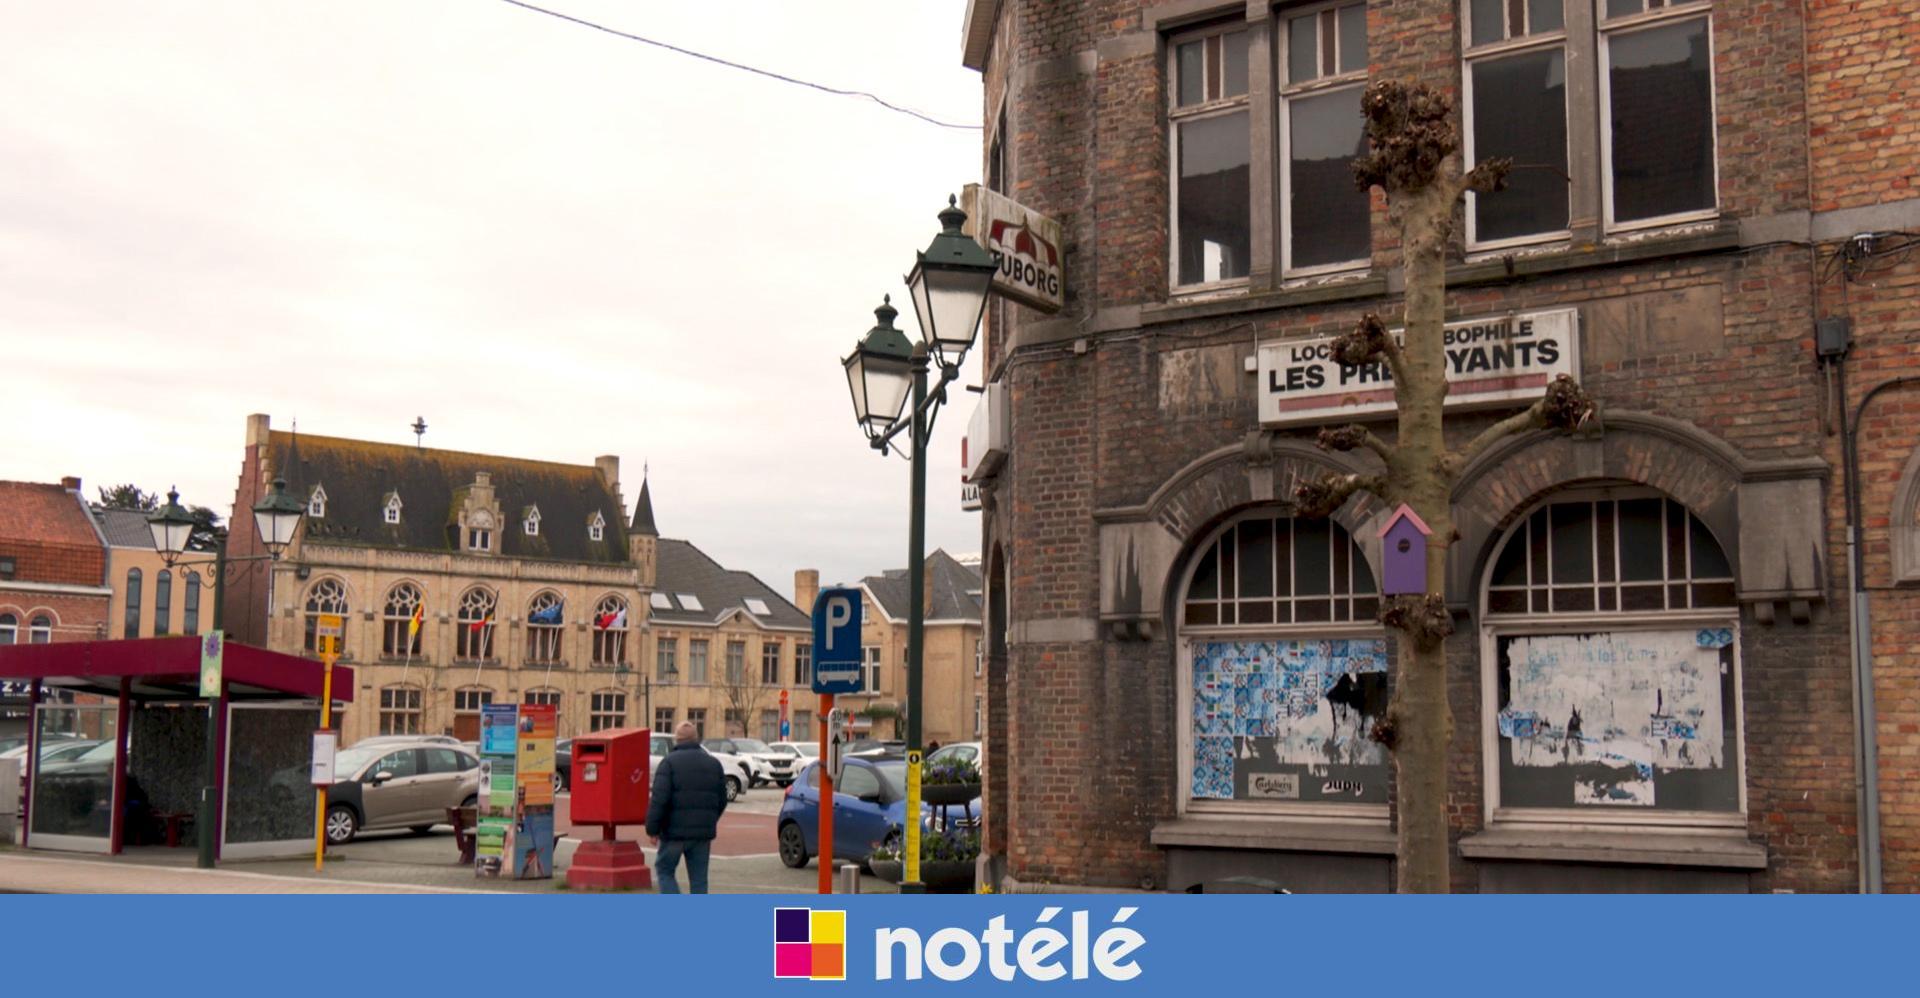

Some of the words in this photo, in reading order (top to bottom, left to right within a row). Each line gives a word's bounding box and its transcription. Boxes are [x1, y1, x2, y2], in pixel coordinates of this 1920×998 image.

[989, 249, 1058, 296] TUBORG
[1269, 364, 1325, 393] LES
[1340, 338, 1560, 385] PRYANTS
[825, 596, 852, 651] P
